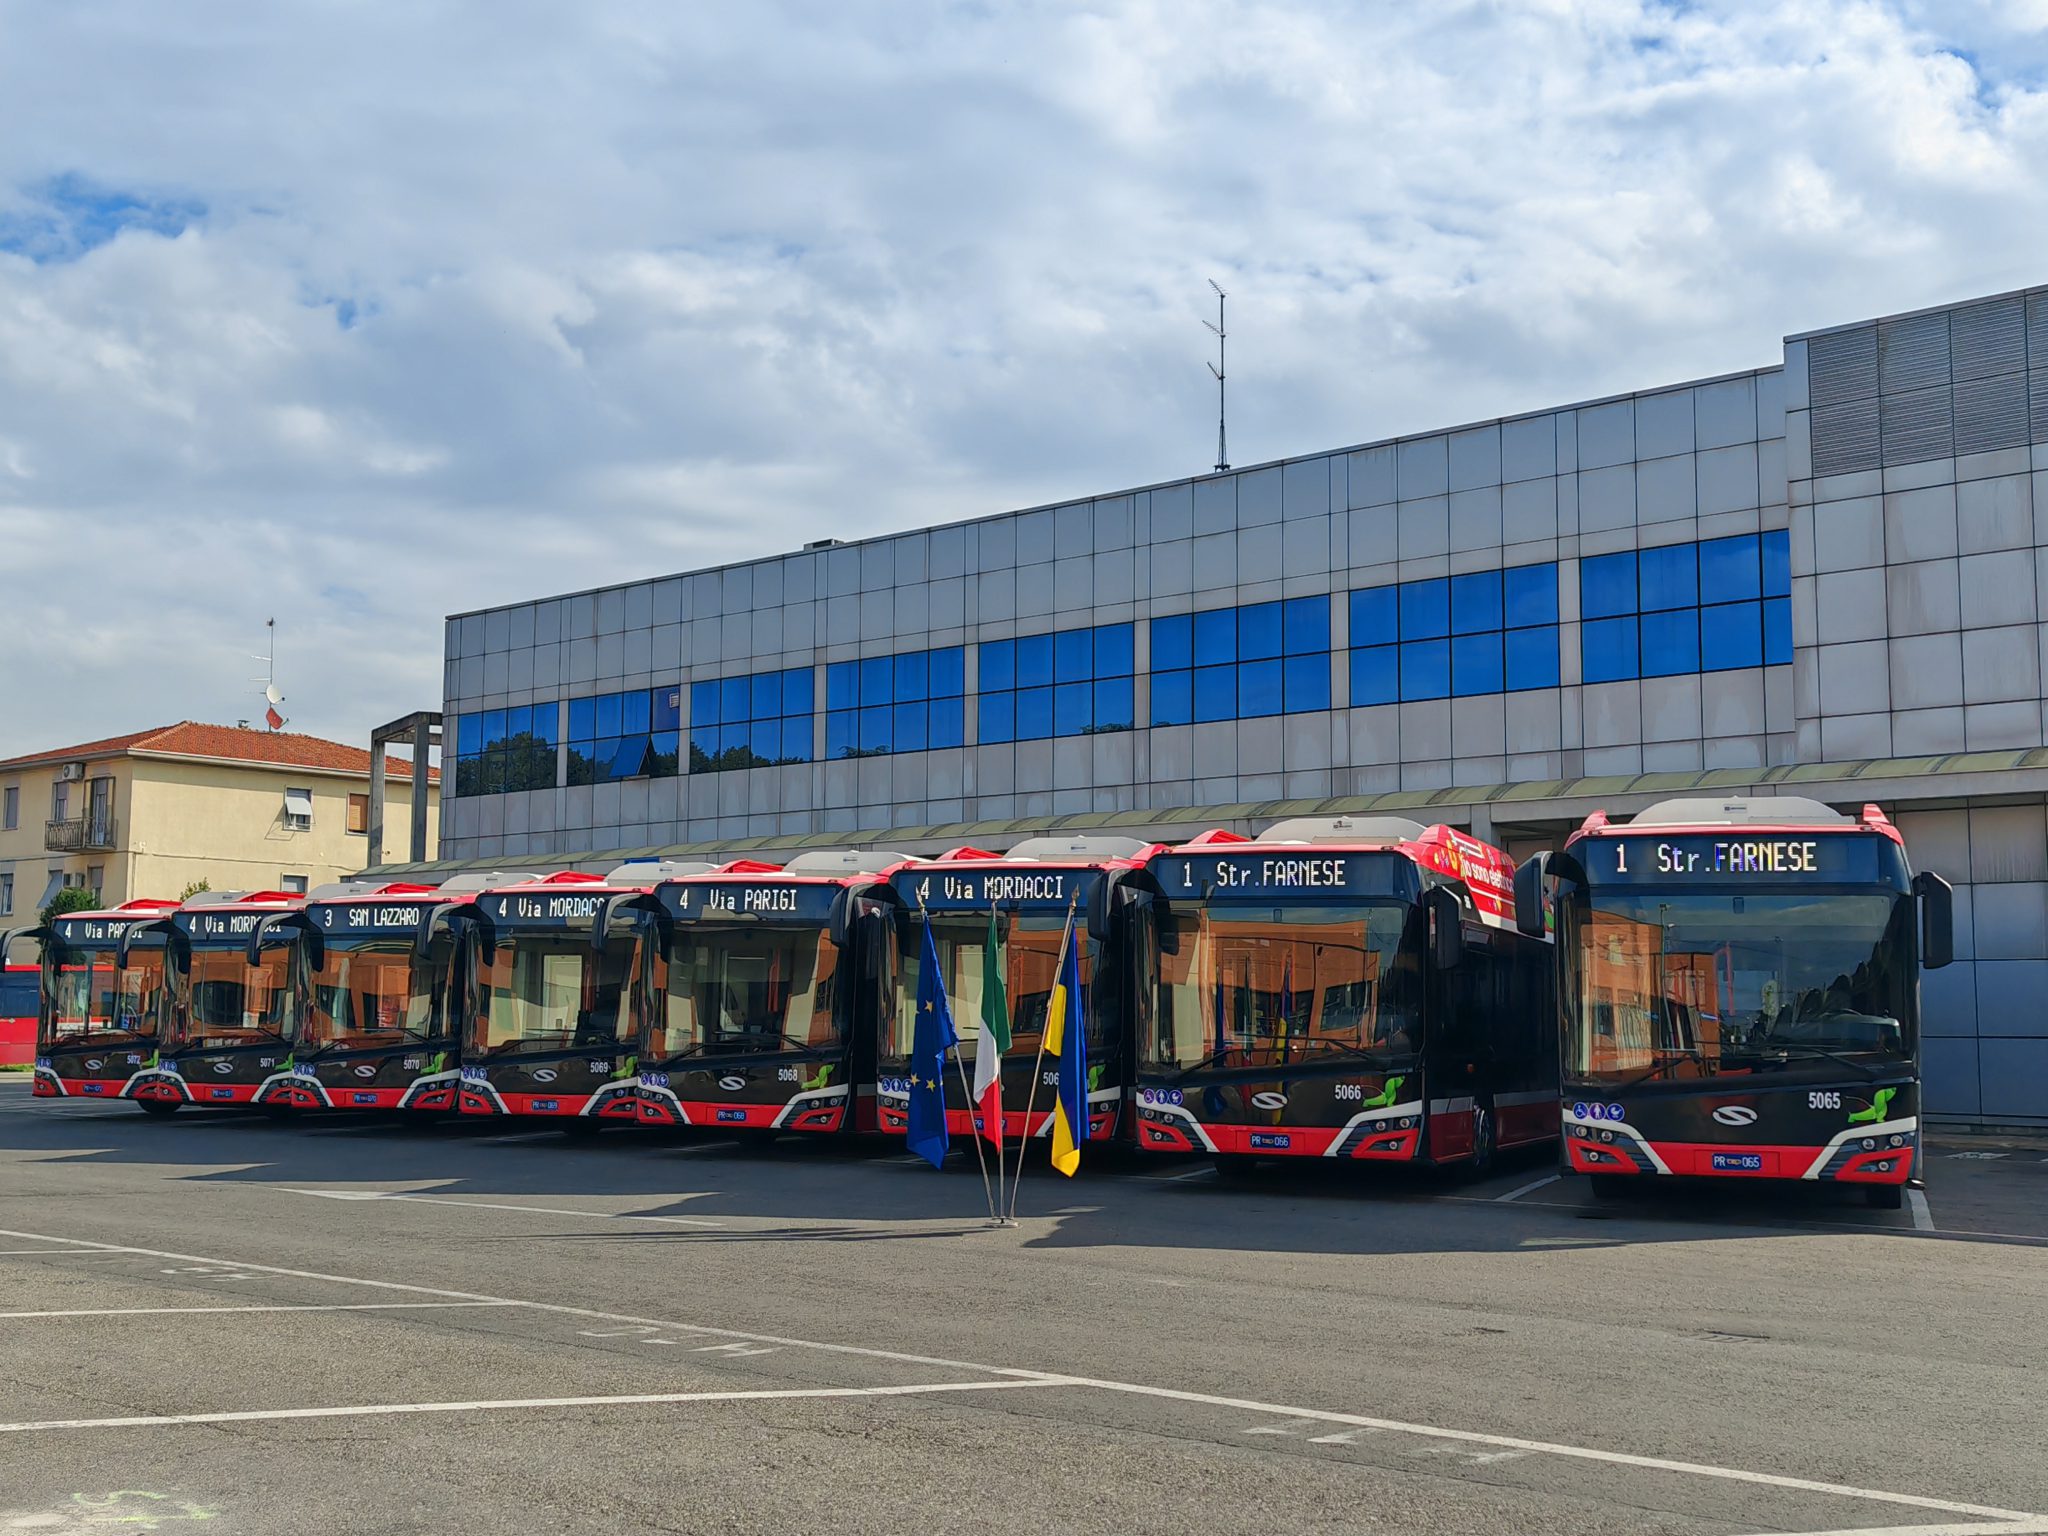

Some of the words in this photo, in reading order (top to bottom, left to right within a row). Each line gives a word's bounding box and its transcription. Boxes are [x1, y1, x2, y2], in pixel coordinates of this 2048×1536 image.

[1616, 843, 1628, 873] 1
[1183, 861, 1193, 887] 1
[1471, 863, 1490, 885] sono
[920, 876, 930, 900] 4
[944, 876, 974, 900] Via
[983, 875, 1064, 900] MORDACCI
[498, 897, 507, 918] 4
[518, 897, 542, 918] Via
[548, 897, 605, 918] MORDAC
[679, 888, 689, 910] 4
[709, 888, 736, 910] Via
[744, 888, 797, 911] PARIGI
[188, 915, 196, 933] 4
[204, 915, 225, 933] Via
[324, 908, 333, 927] 3
[348, 907, 370, 927] SAN
[373, 907, 420, 927] LAZZARO
[64, 922, 72, 939] 4
[84, 922, 103, 939] Via
[259, 1057, 275, 1068] 5071
[403, 1059, 420, 1070] 5070
[589, 1061, 609, 1073] 5069
[777, 1068, 798, 1082] 5068
[1042, 1071, 1060, 1085] 506
[1334, 1084, 1361, 1100] 5066
[1808, 1092, 1841, 1109] 5065
[1251, 1135, 1261, 1146] PR
[1274, 1136, 1289, 1147] 066
[1713, 1155, 1726, 1167] PR
[1741, 1156, 1760, 1168] 065
